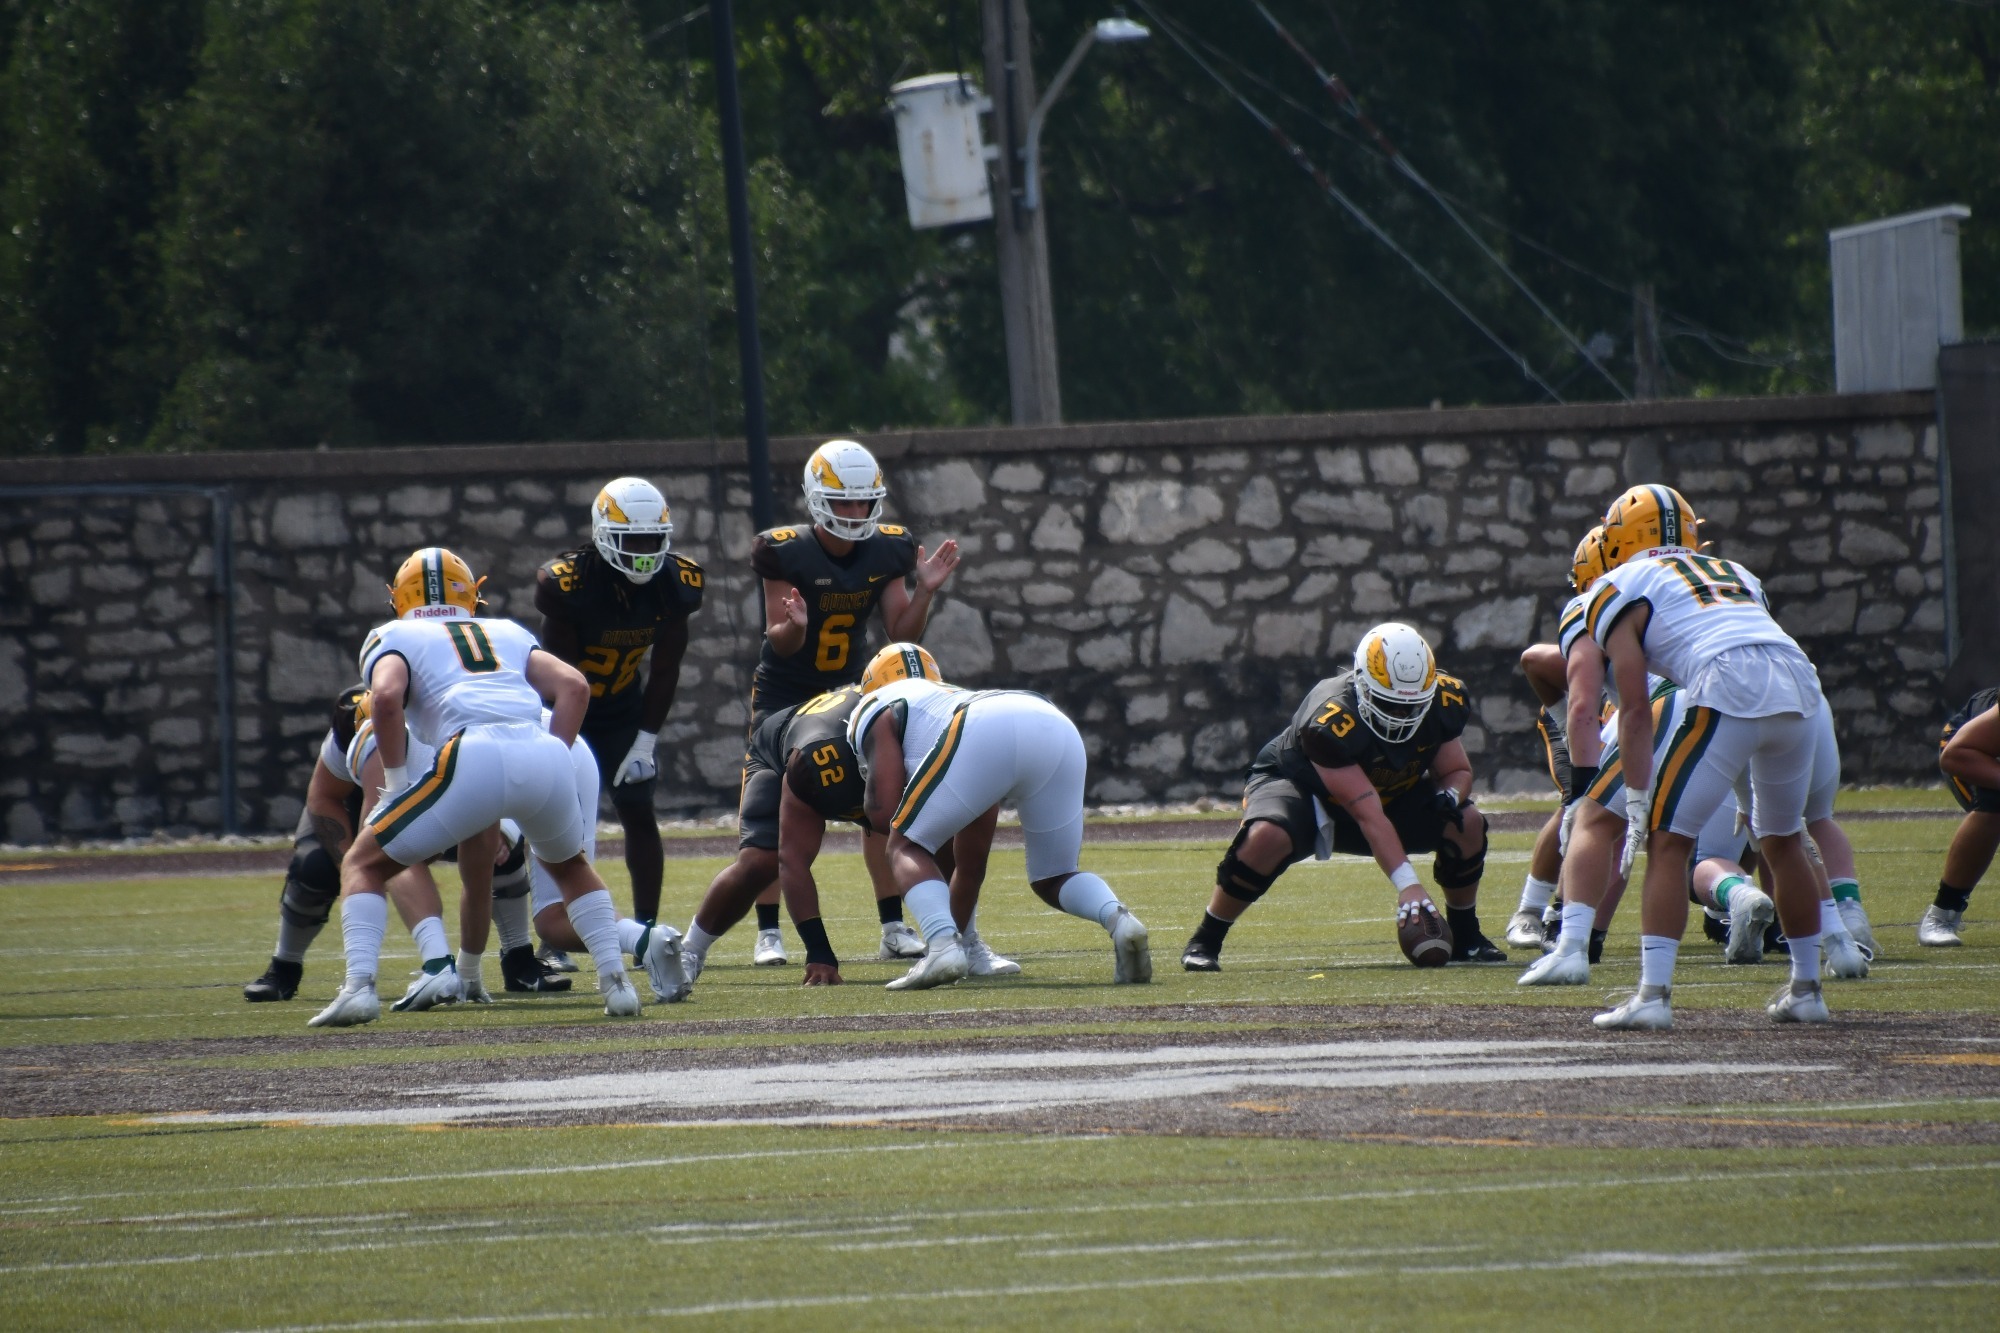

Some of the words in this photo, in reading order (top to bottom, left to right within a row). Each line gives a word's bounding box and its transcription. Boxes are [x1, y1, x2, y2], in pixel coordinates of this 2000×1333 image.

[771, 529, 797, 541] 6
[1665, 509, 1675, 544] CATS
[429, 570, 440, 602] CATS
[1656, 554, 1757, 609] 19
[414, 607, 457, 619] Riddell
[819, 589, 872, 612] QUINCY
[444, 621, 501, 674] 0
[815, 614, 855, 672] 6
[578, 646, 648, 698] 28
[907, 651, 920, 678] CATS
[1437, 675, 1463, 707] 73
[1316, 702, 1356, 738] 73
[812, 744, 845, 787] 52
